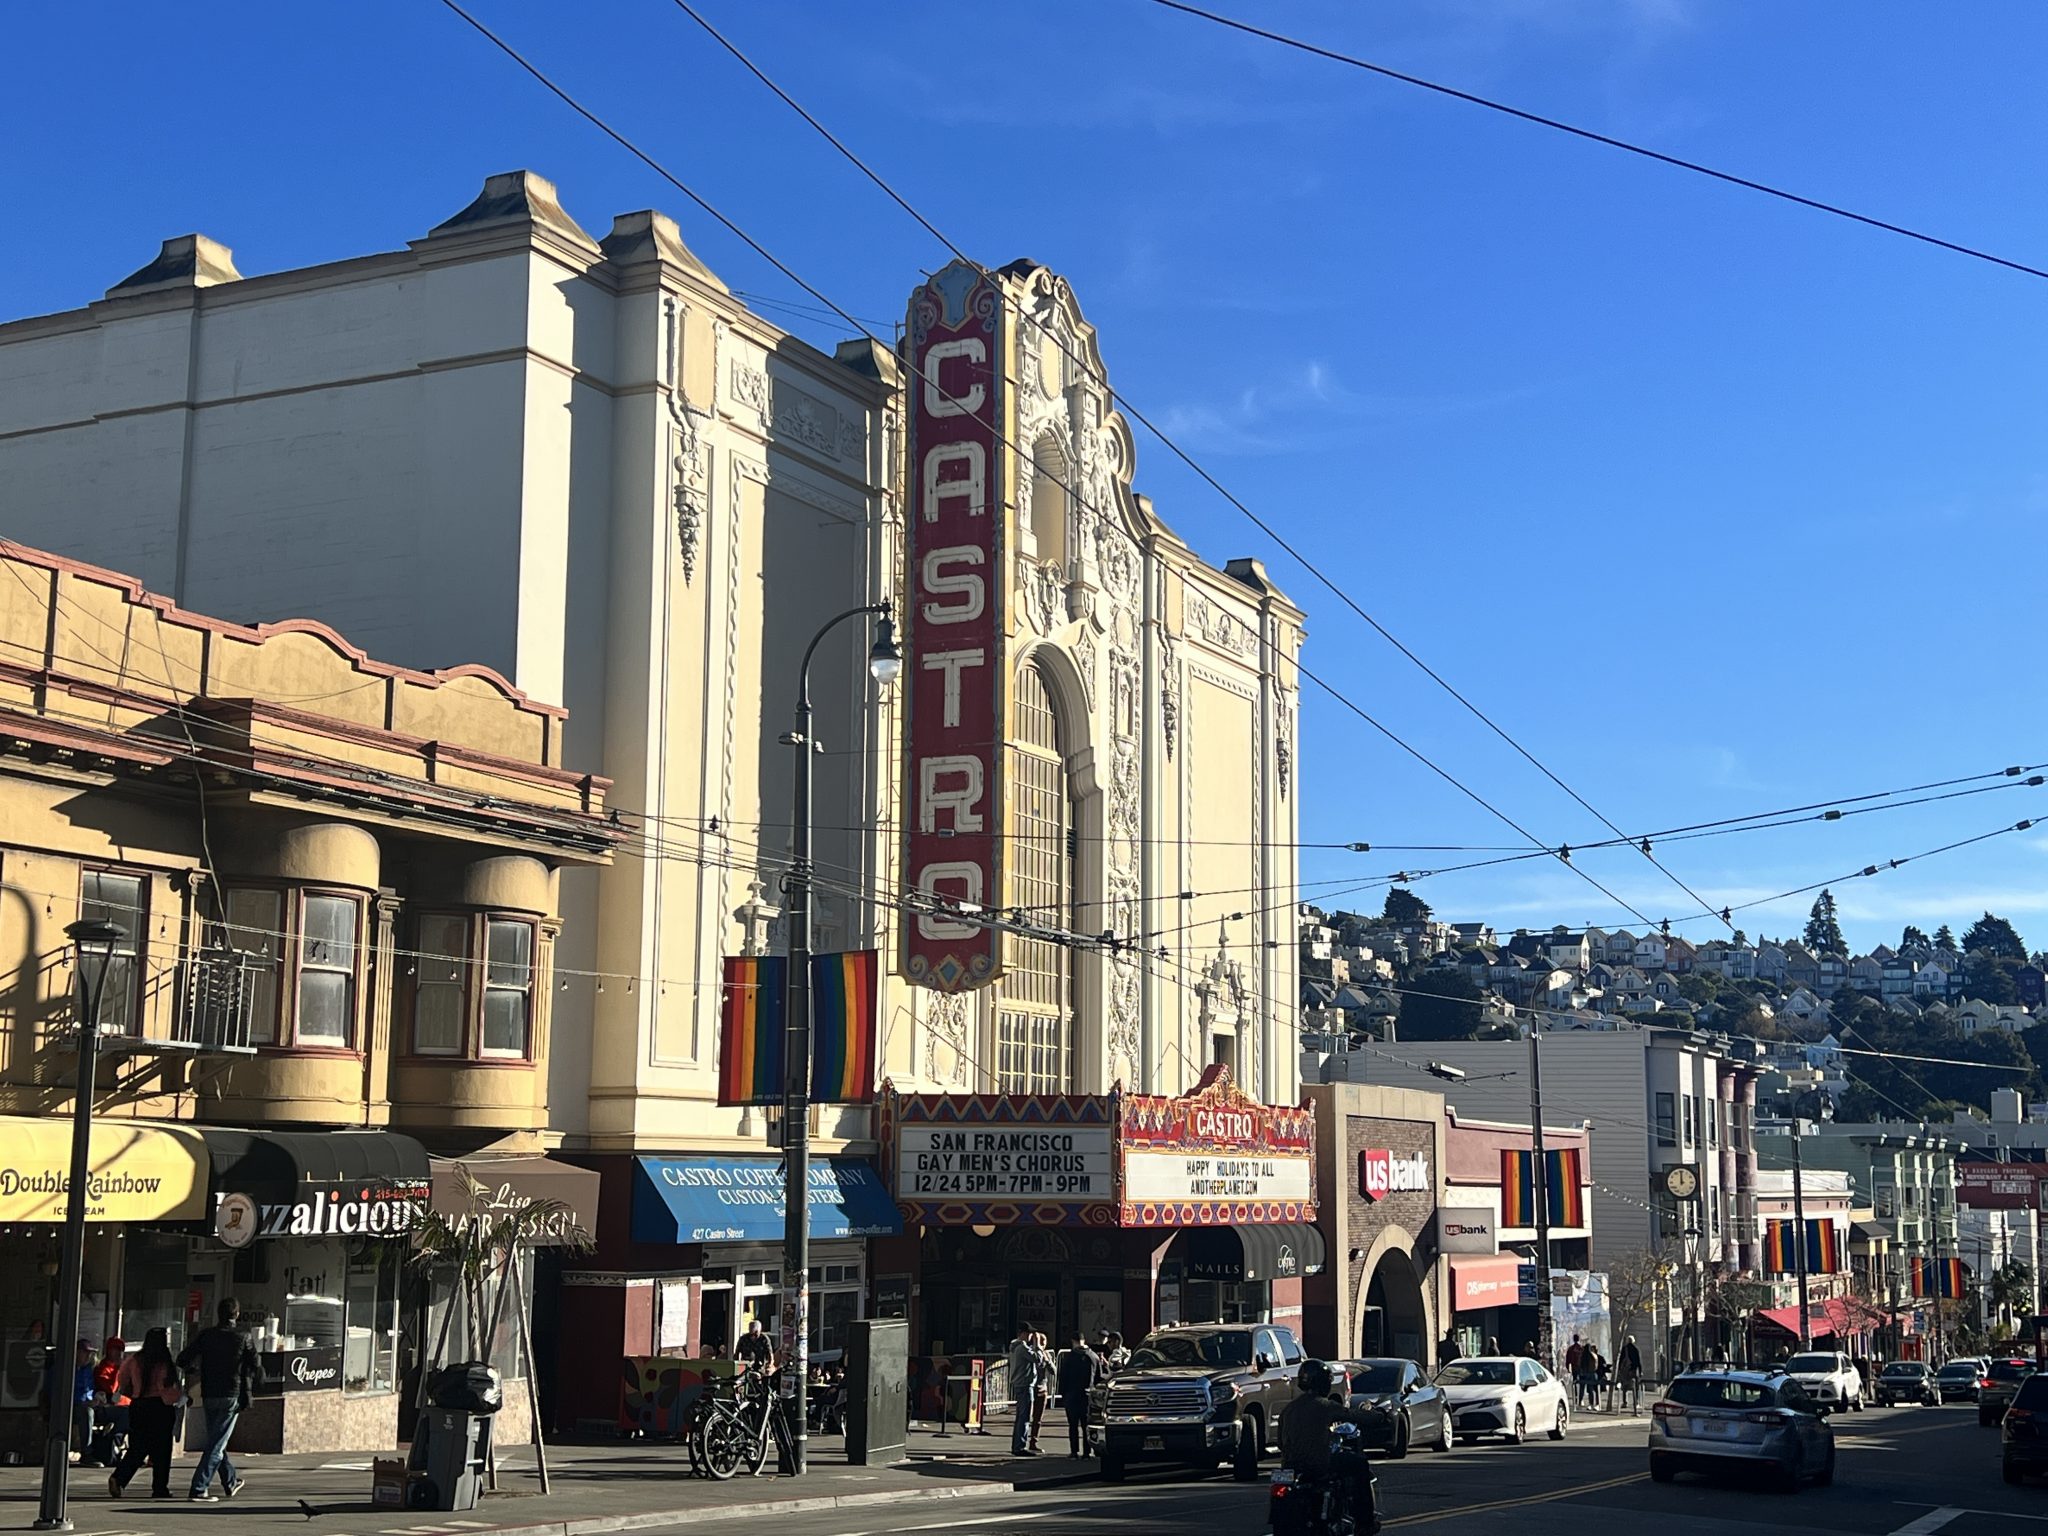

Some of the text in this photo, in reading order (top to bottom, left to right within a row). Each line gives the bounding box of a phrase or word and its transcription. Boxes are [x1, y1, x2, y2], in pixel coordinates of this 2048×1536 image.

[917, 336, 986, 940] CASTRO
[1196, 1110, 1252, 1139] CASTRO
[930, 1133, 1073, 1152] SAN FRANCISCO
[917, 1154, 1085, 1172] GAY MEN'S CHORUS
[1186, 1160, 1274, 1177] HAPPY HOLIDAYS TO ALL
[0, 1169, 161, 1201] Double Rainbow
[662, 1167, 867, 1186] CASTRO COFFE OMPANY
[915, 1174, 961, 1192] 12/24
[1056, 1175, 1090, 1193] 9PM
[718, 1188, 845, 1205] CUSTOM RSTERS
[439, 1211, 577, 1238] HAR SIGN
[692, 1228, 745, 1240] 427 Castro Street
[1194, 1263, 1240, 1275] NAILS
[290, 1356, 336, 1386] Crepes
